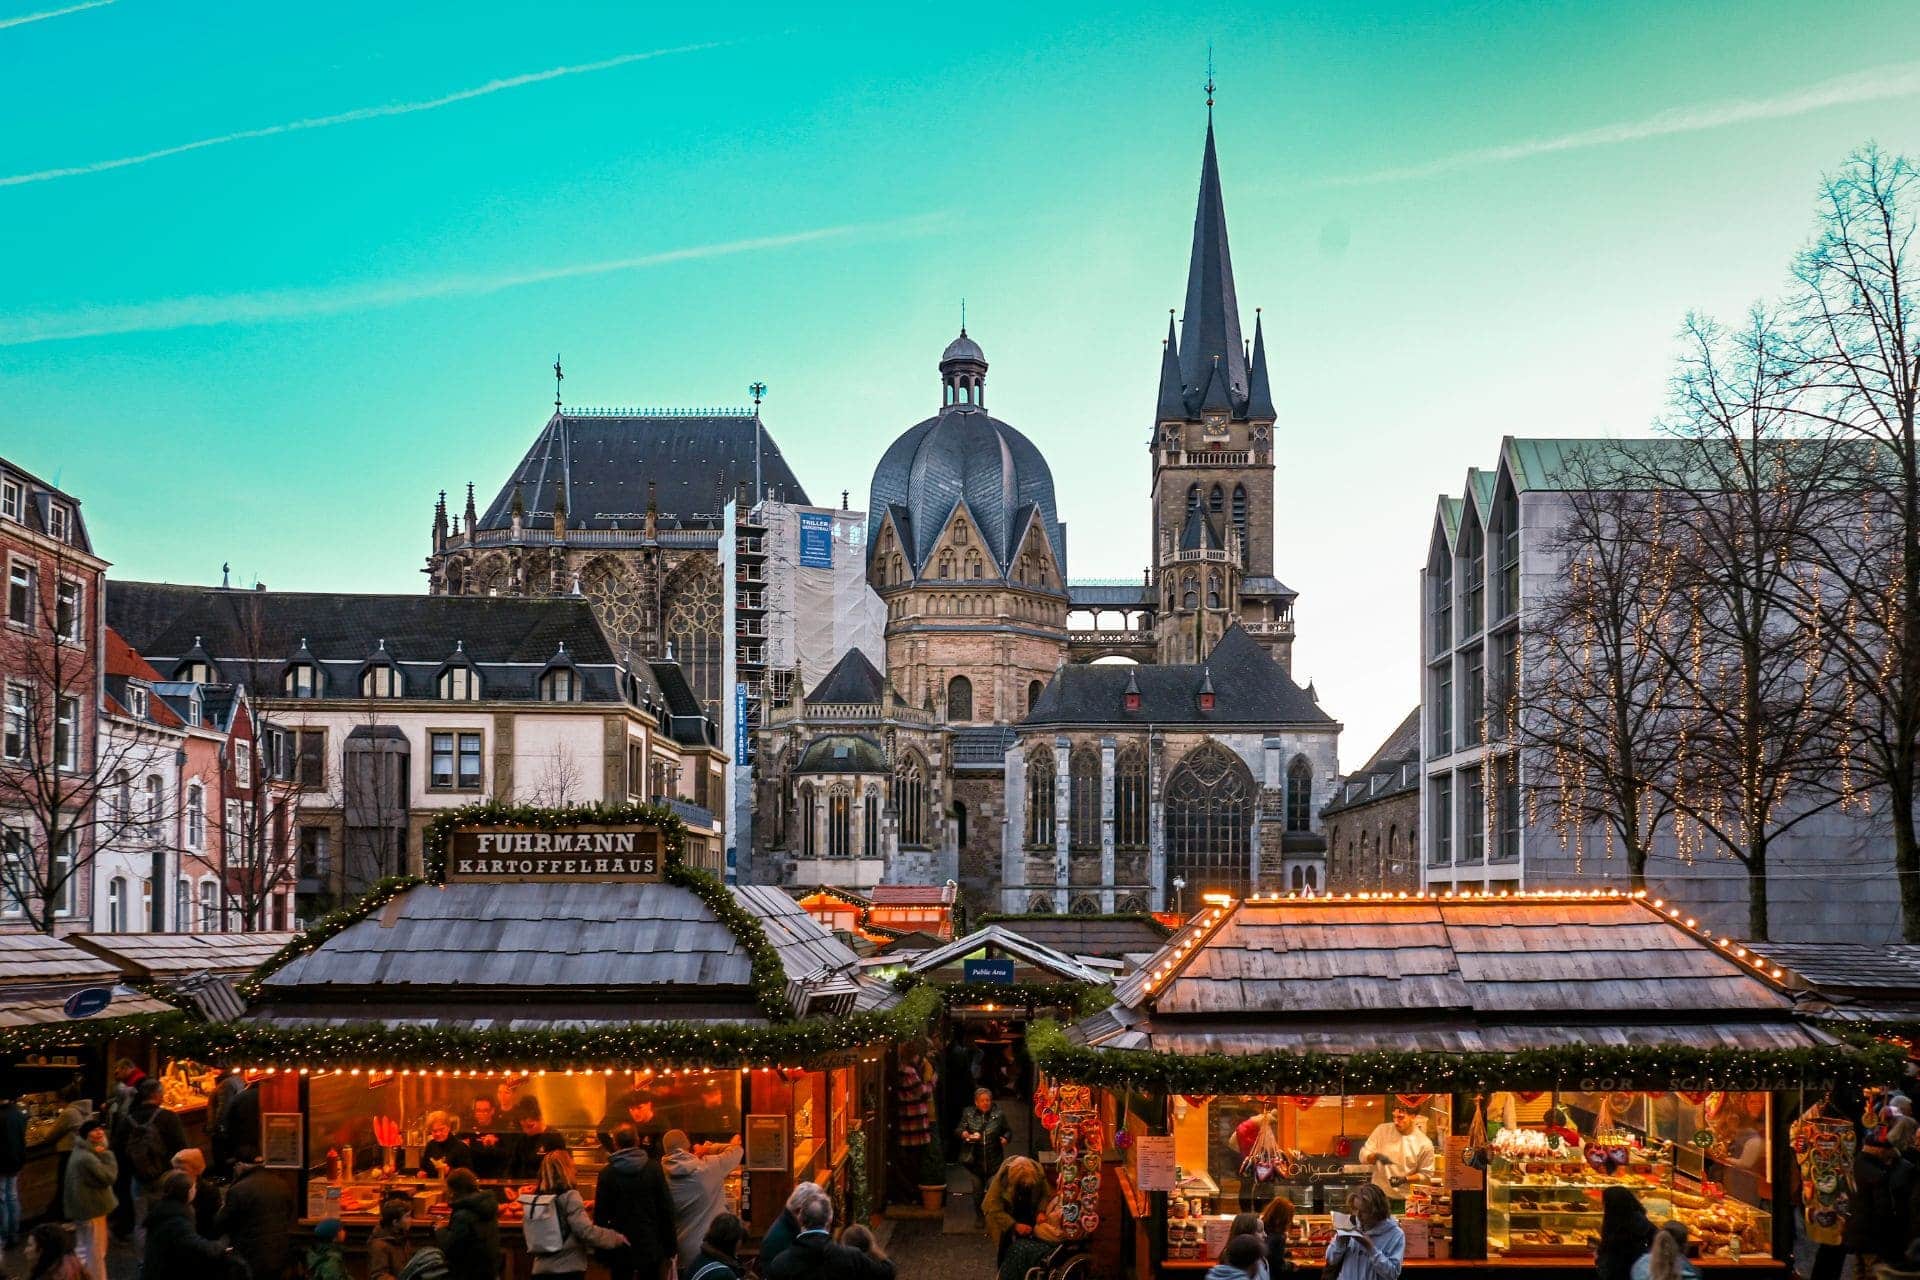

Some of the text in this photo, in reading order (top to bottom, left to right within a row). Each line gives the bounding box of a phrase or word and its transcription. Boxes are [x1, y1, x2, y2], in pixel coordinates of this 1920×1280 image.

[477, 833, 636, 853] FUHRMANN
[458, 858, 654, 873] KARTOFFELHAUS
[972, 968, 991, 976] Public
[1288, 1163, 1320, 1182] Only
